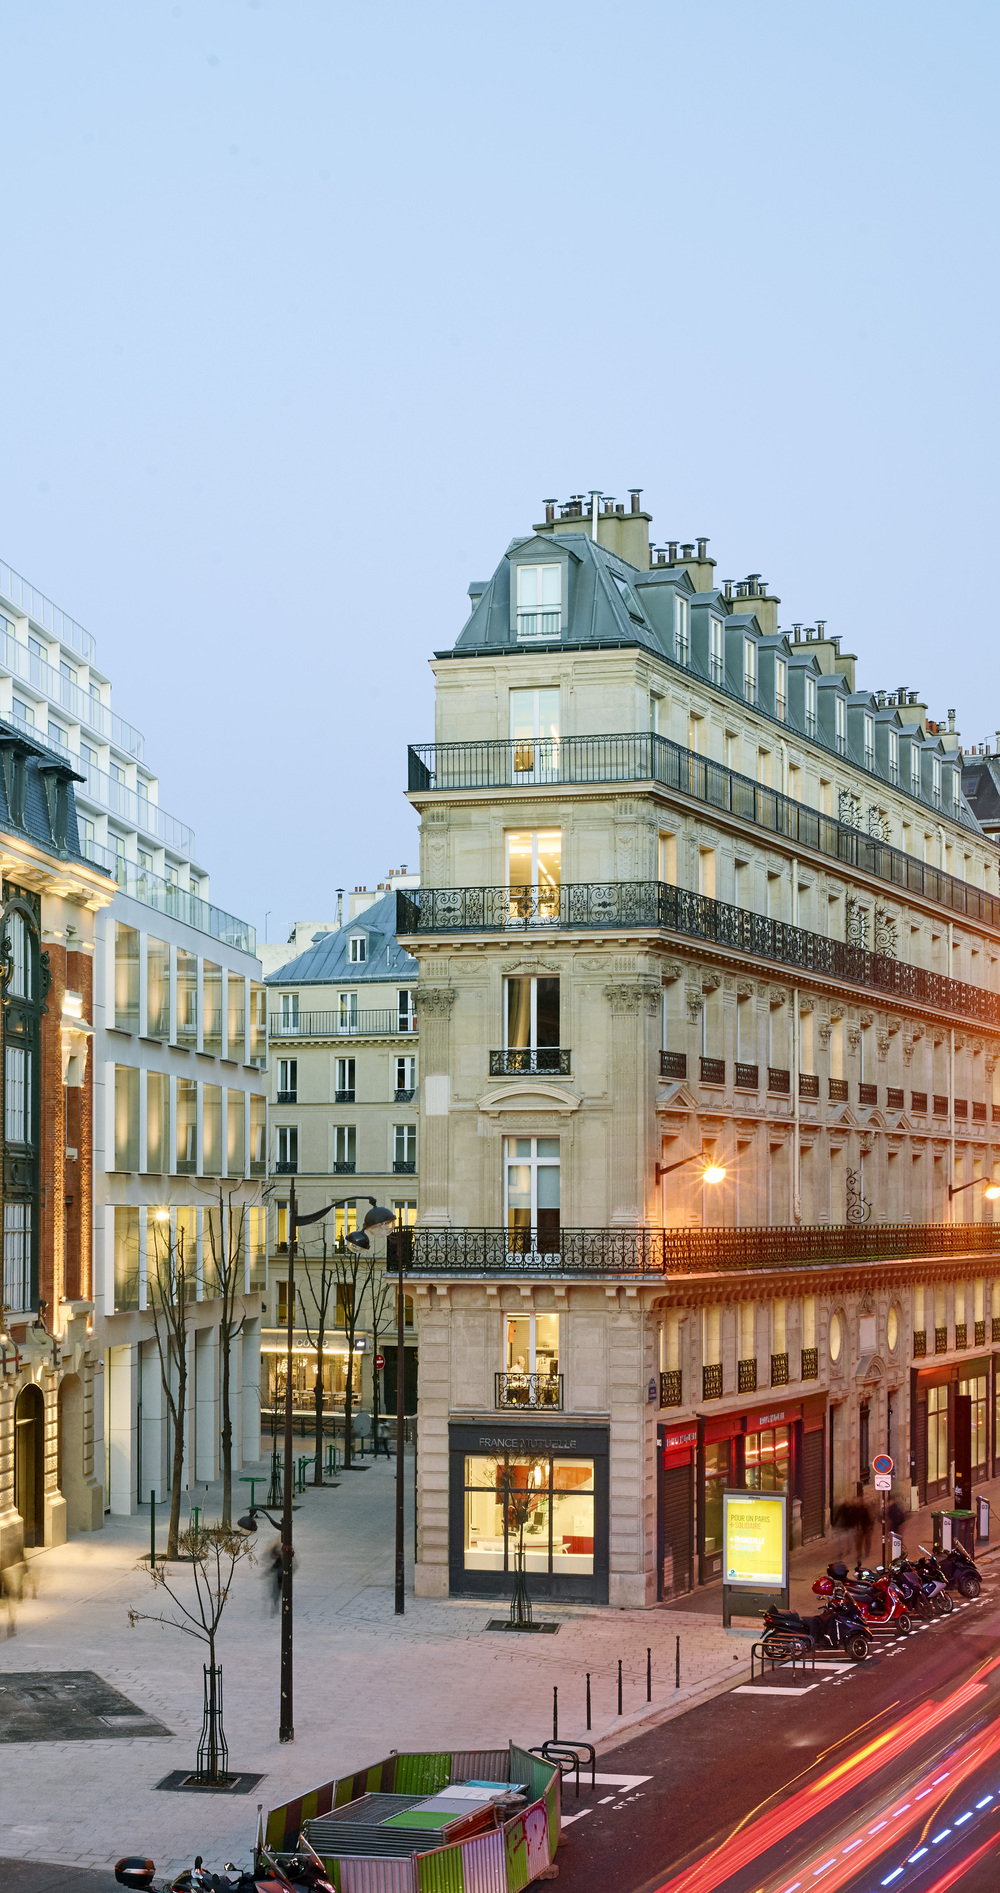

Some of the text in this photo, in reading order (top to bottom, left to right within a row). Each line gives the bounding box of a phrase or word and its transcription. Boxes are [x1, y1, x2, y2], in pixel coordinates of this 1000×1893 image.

[479, 1437, 577, 1449] FRANCE MUTUELLE
[755, 1515, 771, 1523] PARIS
[734, 1522, 762, 1530] SOLIDAIRE
[734, 1536, 765, 1544] TRANQUILLE
